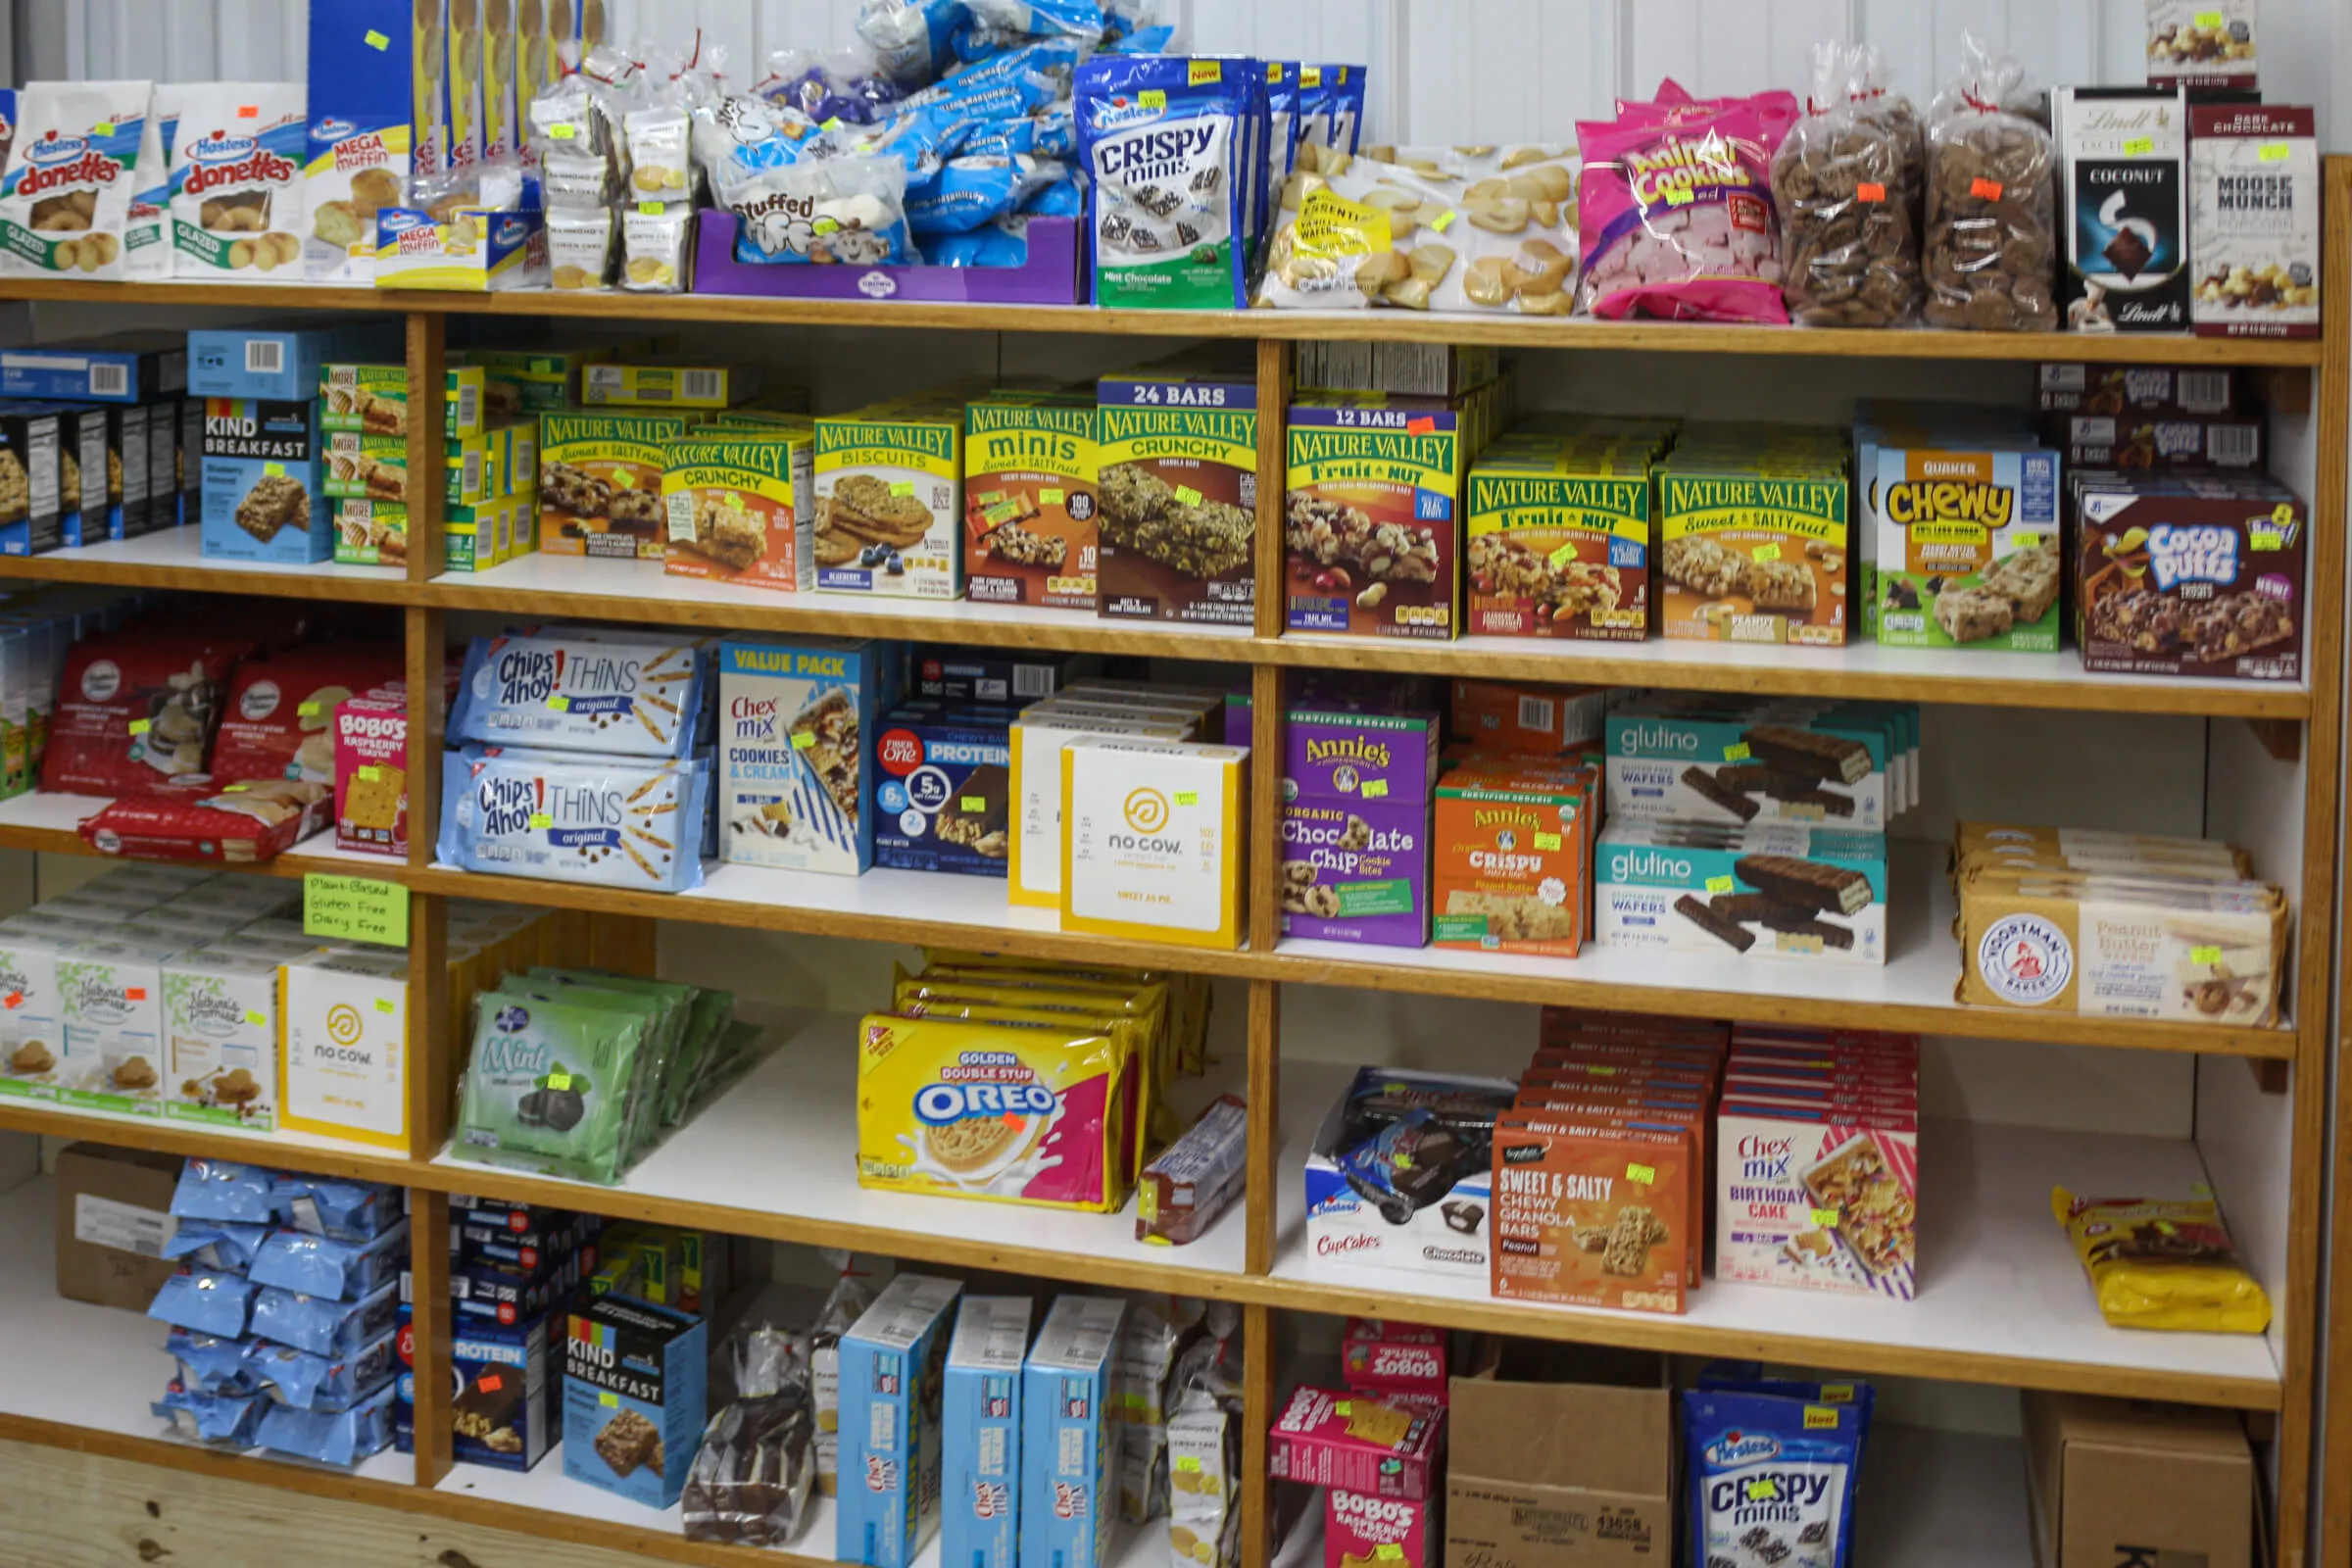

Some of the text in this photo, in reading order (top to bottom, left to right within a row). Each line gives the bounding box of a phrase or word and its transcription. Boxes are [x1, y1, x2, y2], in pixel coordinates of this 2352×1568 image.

[1191, 68, 1218, 80] New
[2214, 122, 2295, 133] CHOCOLATE
[31, 134, 84, 159] Hostess
[196, 133, 255, 157] Hostess
[333, 133, 383, 159] MEGA
[336, 151, 389, 172] muffin
[18, 153, 121, 196] donettes
[185, 153, 295, 195] donettes
[1123, 161, 1190, 186] minis
[2090, 169, 2165, 184] COCONUT
[2218, 175, 2292, 190] MOOSE
[1636, 163, 1751, 205] Cookies
[732, 194, 814, 218] Stuffed
[2218, 195, 2292, 210] MUNCH
[7, 225, 46, 253] GLAZED
[176, 223, 220, 253] GLAZED
[398, 227, 436, 240] MEGA
[399, 238, 439, 255] muffin
[1104, 271, 1172, 284] Mint Chocolate
[2118, 302, 2168, 322] Lindt
[330, 372, 354, 385] MORE
[1134, 386, 1225, 406] 24 BARS
[205, 417, 258, 438] KIND
[972, 408, 1095, 439] NATURE VALLEY
[1336, 409, 1406, 427] 12 BARS
[547, 417, 678, 444] NATURE VALLEY
[1104, 410, 1256, 447] NATURE VALLEY
[205, 439, 306, 458] BREAKFAST
[332, 438, 357, 451] MORE
[611, 444, 642, 459] SALTY
[819, 425, 947, 459] NATURE VALLEY
[988, 432, 1076, 461] minis
[1131, 440, 1231, 460] CRUNCHY
[1293, 432, 1447, 471] NATURE VALLEY
[662, 443, 782, 478] NATURE VALLEY
[841, 451, 926, 467] BISCUITS
[1029, 459, 1056, 469] SALTY
[684, 469, 762, 490] CRUNCHY
[1311, 463, 1371, 480] Fruit
[1388, 468, 1424, 484] NUT
[1924, 462, 1976, 477] QUAKER
[1072, 495, 1089, 509] 100
[1476, 479, 1641, 518] NATURE VALLEY
[1671, 479, 1838, 518] NATURE VALLEY
[344, 504, 369, 516] MORE
[1501, 511, 1563, 527] Fruit
[1582, 515, 1619, 530] NUT
[1685, 515, 1738, 534] Sweet
[1753, 514, 1792, 529] SALTY
[1793, 520, 1831, 537] nut
[2147, 526, 2235, 559] Cocoa
[2153, 553, 2237, 588] Puffs
[2256, 575, 2289, 600] NEW!
[500, 651, 555, 683] Chips
[735, 650, 846, 676] VALUE PACK
[575, 699, 618, 711] original
[731, 697, 779, 718] Chex
[339, 715, 408, 739] BOBO'S
[736, 715, 775, 739] mix
[1291, 713, 1407, 729] CERTIFIED ORGANIC
[344, 736, 403, 753] RASPBERRY
[887, 739, 913, 748] FIBER
[947, 732, 984, 743] CHEWY
[1621, 723, 1697, 756] glutino
[730, 748, 790, 764] COOKIES
[883, 747, 917, 762] One
[931, 744, 1009, 763] PROTEIN
[1306, 735, 1391, 768] Annie's
[730, 764, 790, 780] & CREAM
[1622, 772, 1674, 785] WAFERS
[480, 778, 533, 810] Chips
[921, 775, 940, 794] 5g
[1461, 791, 1552, 803] CERTIFIED ORGANIC
[1286, 807, 1344, 821] ORGANIC
[1474, 807, 1543, 831] Annie's
[563, 829, 608, 845] original
[1108, 835, 1182, 854] no cow.
[1310, 849, 1358, 874] Chip
[1359, 855, 1391, 866] Cookie
[1359, 863, 1383, 875] Bites
[1612, 849, 1691, 883] glutino
[1475, 880, 1535, 892] Peanut Butter
[311, 895, 386, 915] Gluten Free
[1117, 891, 1156, 904] SWEET AS
[1612, 900, 1666, 914] WAFERS
[312, 911, 386, 934] Dairy Free
[2097, 921, 2161, 939] Peanut
[2098, 937, 2160, 952] Butter
[80, 977, 127, 997] Nature's
[191, 989, 241, 1011] Nature's
[315, 1044, 336, 1058] no
[483, 1038, 547, 1072] Mint
[959, 1052, 1016, 1066] GOLDEN
[942, 1066, 1035, 1081] DOUBLE STUF
[916, 1083, 1054, 1120] OREO
[1544, 1101, 1576, 1112] SWEET
[1586, 1103, 1615, 1117] SALTY
[1527, 1121, 1558, 1135] SWEET
[1568, 1124, 1598, 1138] SALTY
[1738, 1135, 1796, 1159] Chex
[1743, 1154, 1794, 1181] mix
[1499, 1167, 1548, 1195] SWEET
[1567, 1176, 1613, 1202] SALTY
[1499, 1193, 1558, 1210] CHEWY
[1730, 1186, 1806, 1205] BIRTHDAY
[1313, 1200, 1358, 1215] Hostess
[1748, 1203, 1788, 1220] CAKE
[1499, 1209, 1577, 1228] GRANOLA
[1499, 1223, 1540, 1239] BARS
[1317, 1233, 1381, 1255] CupCakes
[1502, 1240, 1538, 1253] Peanut
[1424, 1247, 1484, 1263] Chocolate
[454, 1342, 521, 1363] ROTEIN
[566, 1337, 614, 1369] KIND
[1373, 1357, 1439, 1378] BOBO'S
[566, 1359, 660, 1400] BREAKFAST
[1715, 1441, 1775, 1463] Hostess
[972, 1479, 995, 1519] Chex
[1052, 1479, 1073, 1519] Chex
[1331, 1489, 1415, 1528] BOBO'S
[1734, 1502, 1801, 1527] minis
[1336, 1512, 1408, 1542] RASPBERRY
